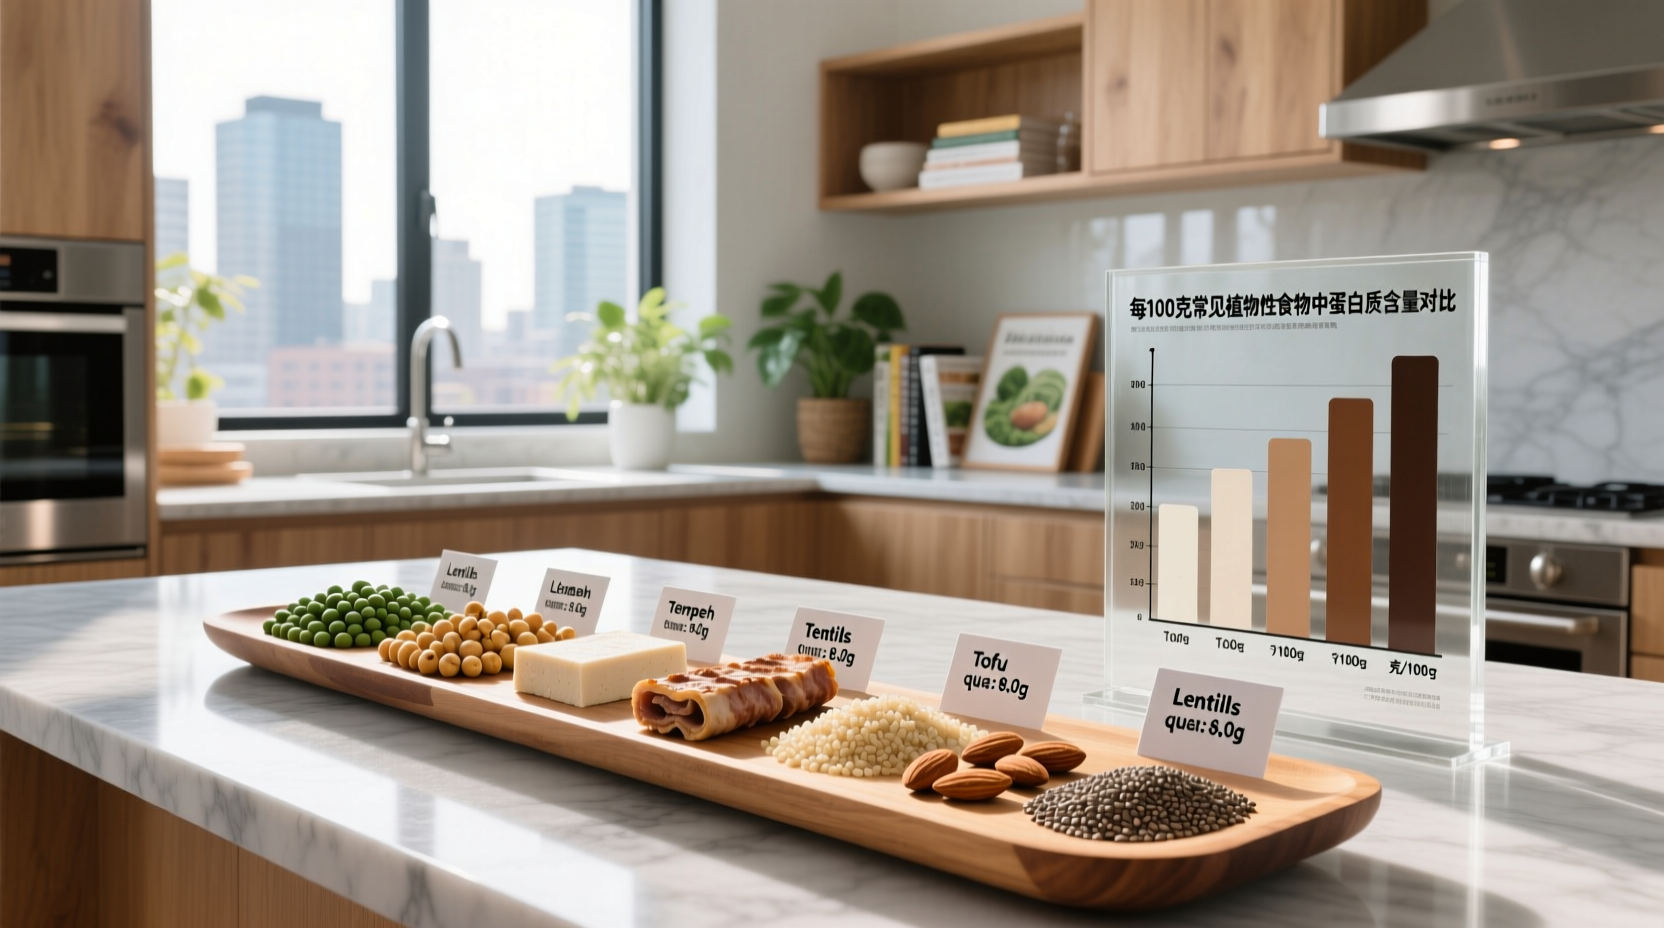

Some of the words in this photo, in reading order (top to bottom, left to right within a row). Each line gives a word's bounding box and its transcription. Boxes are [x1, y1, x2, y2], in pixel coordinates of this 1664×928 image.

[1130, 288, 1457, 320] 每100克常见植物性食物中蛋白质含量对比
[805, 622, 852, 644] Tentils
[973, 650, 1009, 672] Tofu
[1172, 687, 1242, 716] Lentills
